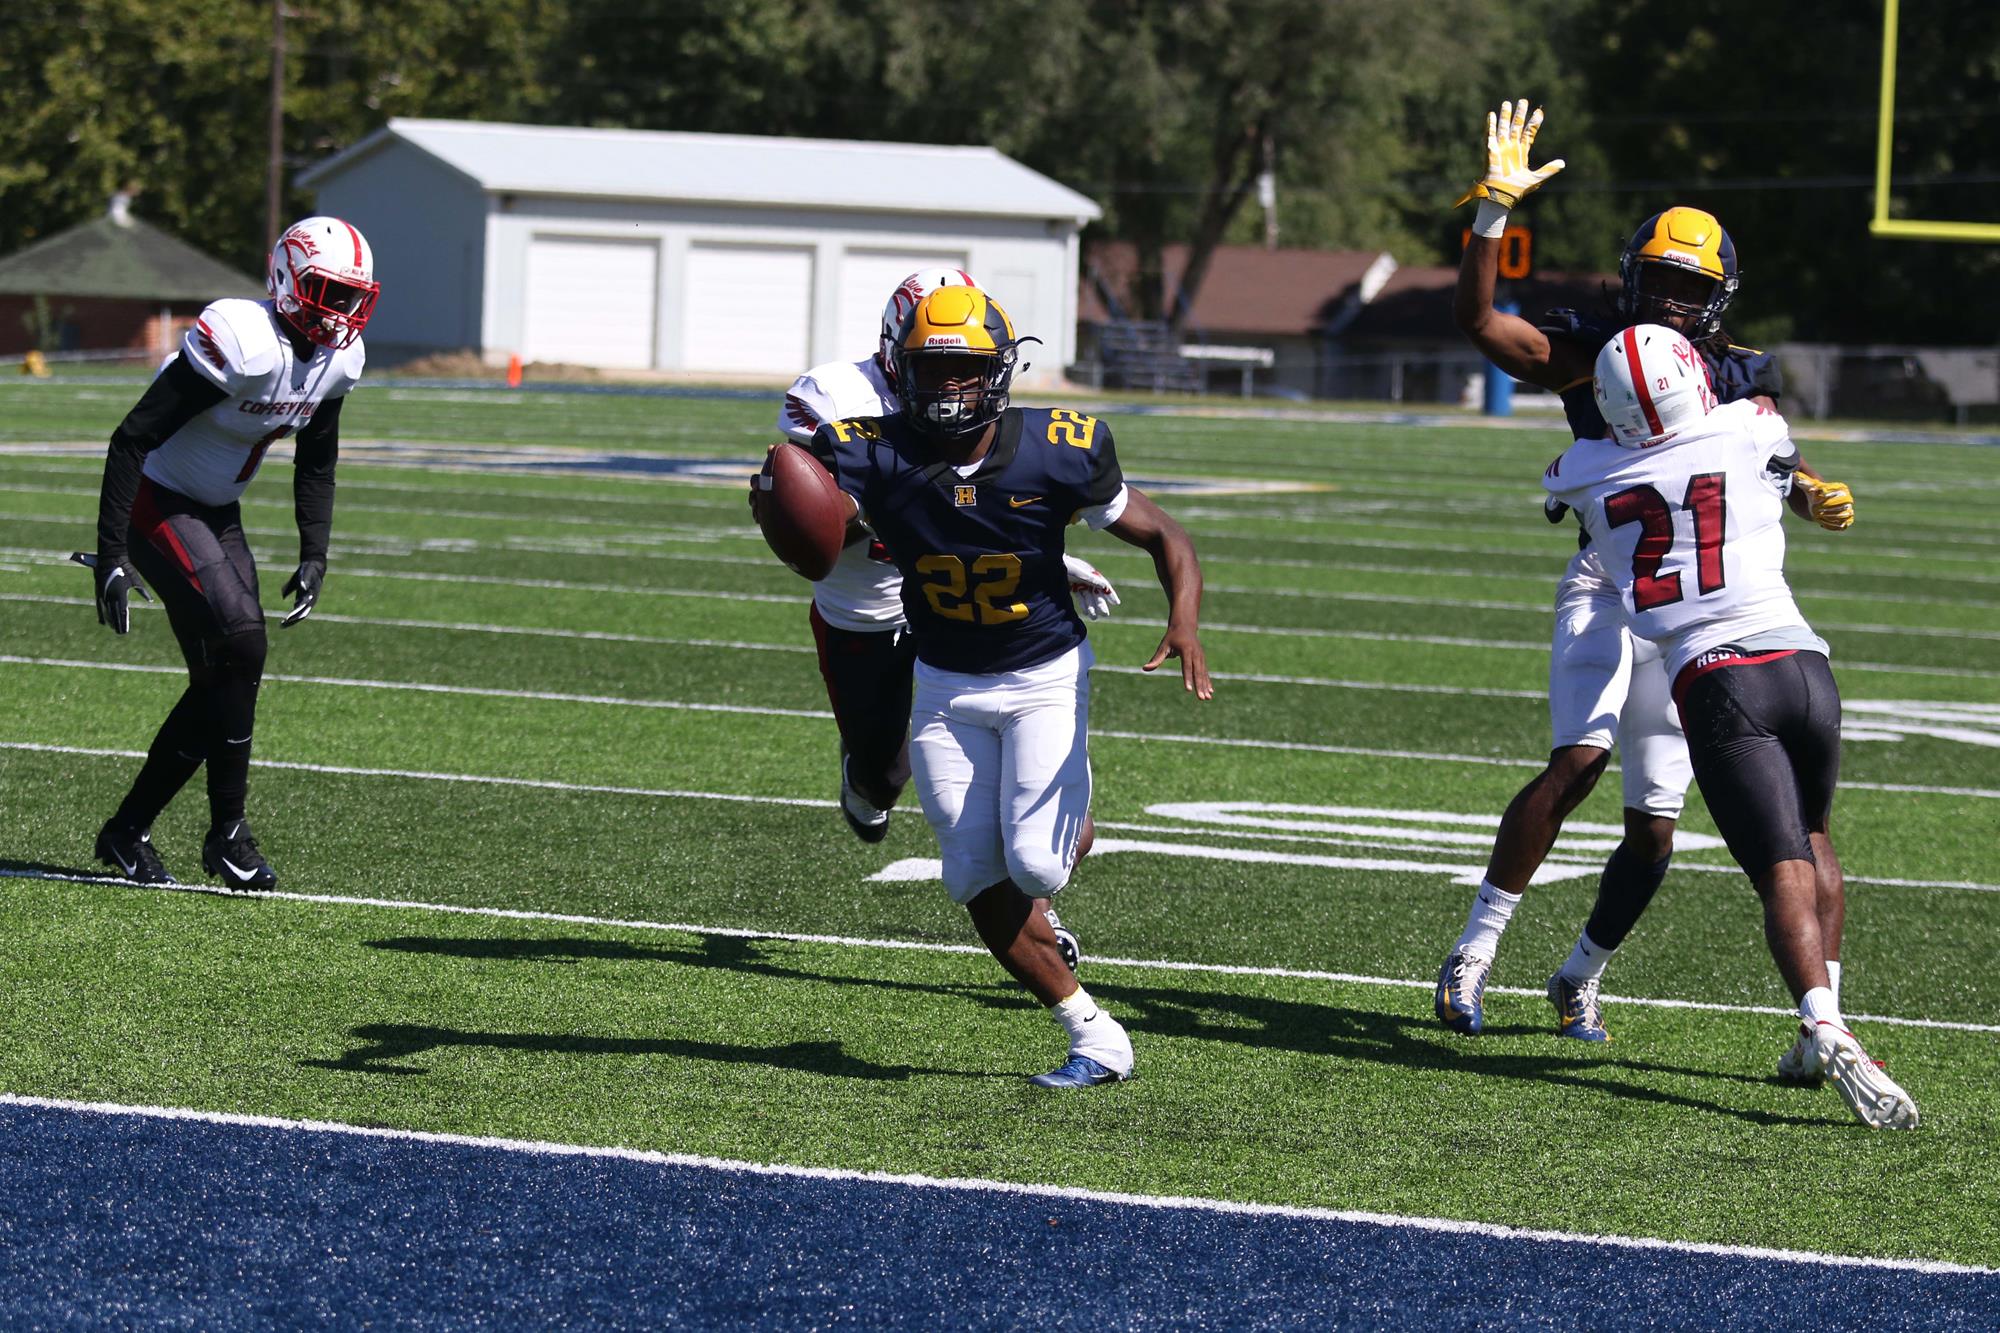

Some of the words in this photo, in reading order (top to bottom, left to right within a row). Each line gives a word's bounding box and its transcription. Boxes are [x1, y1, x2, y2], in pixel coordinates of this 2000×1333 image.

[928, 337, 961, 345] Riddell
[1657, 377, 1670, 391] 21
[1047, 409, 1097, 449] 22
[234, 424, 294, 483] 1
[954, 485, 976, 507] H
[1604, 472, 1726, 613] 21
[915, 553, 1029, 625] 22
